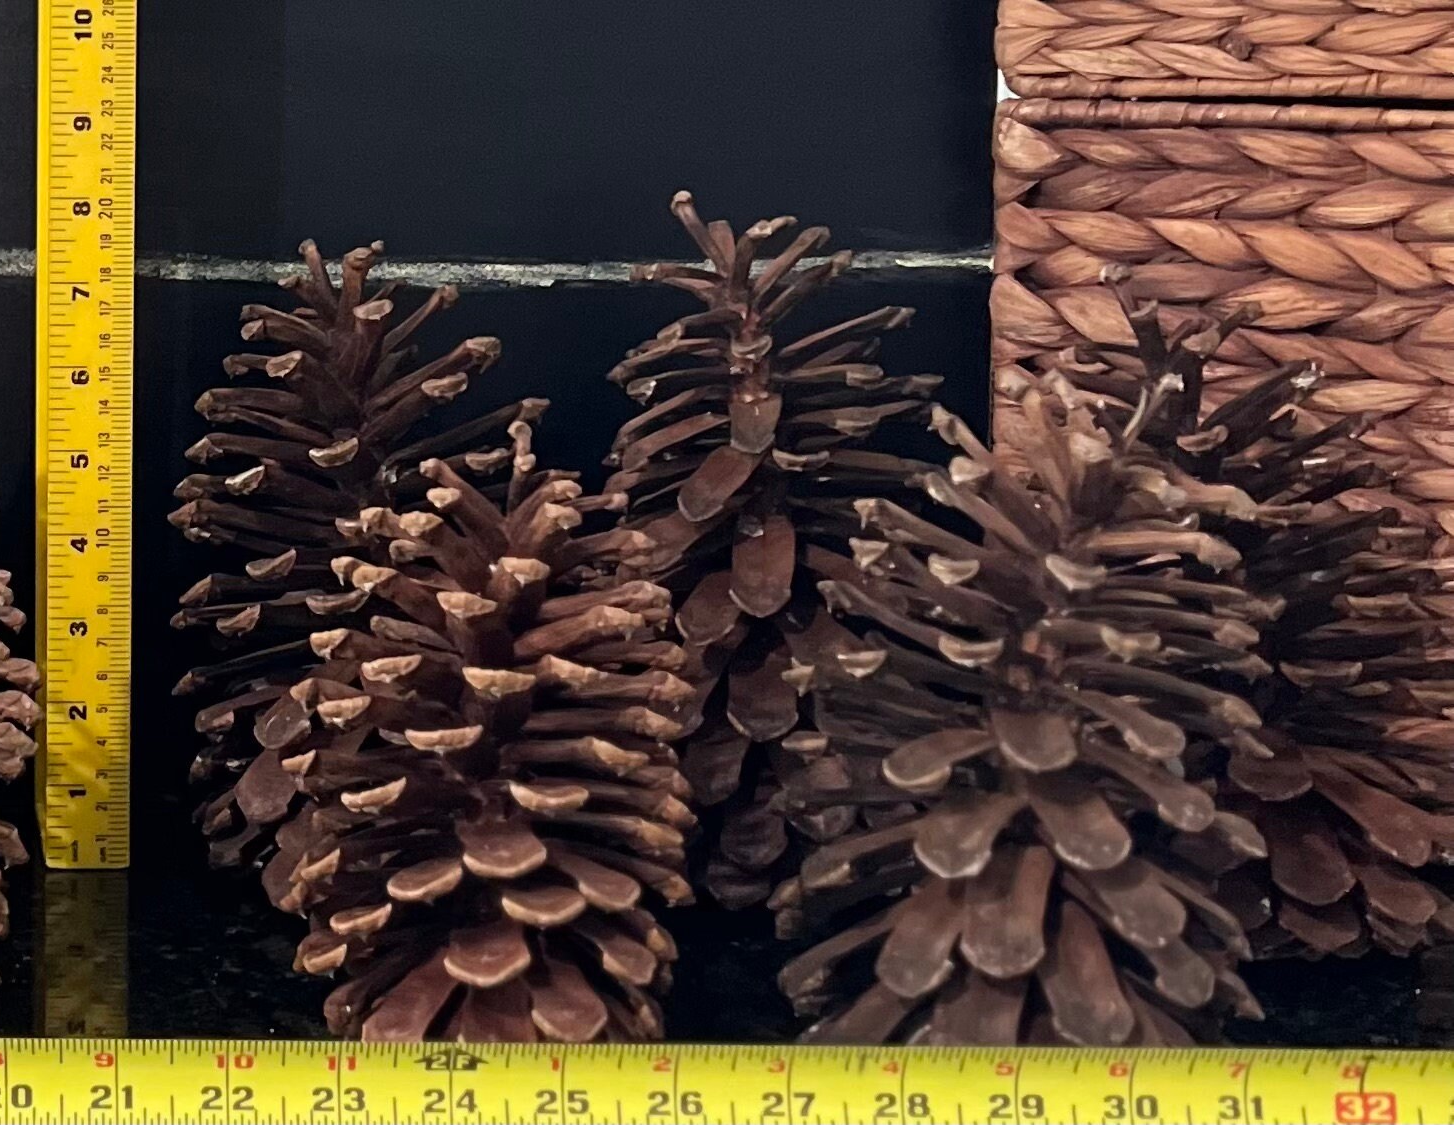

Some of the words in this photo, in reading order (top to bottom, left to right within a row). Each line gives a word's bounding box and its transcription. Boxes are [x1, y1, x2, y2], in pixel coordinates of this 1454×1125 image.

[74, 9, 92, 41] 10
[102, 32, 114, 50] 25
[101, 66, 113, 83] 24
[101, 100, 113, 117] 23
[74, 116, 92, 131] 9
[101, 134, 113, 150] 22
[101, 167, 112, 184] 21
[73, 202, 91, 216] 8
[98, 198, 113, 219] 20
[100, 234, 112, 249] 19
[100, 267, 111, 282] 18
[72, 287, 90, 301] 7
[100, 301, 111, 315] 17
[99, 333, 111, 349] 16
[71, 370, 89, 385] 6
[99, 366, 110, 381] 15
[99, 400, 110, 415] 14
[98, 433, 110, 448] 13
[71, 454, 88, 468] 5
[98, 466, 110, 481] 12
[98, 499, 108, 513] 11
[71, 538, 88, 552] 4
[96, 529, 110, 548] 10
[70, 622, 87, 636] 3
[69, 705, 86, 720] 2
[68, 790, 86, 798] 1
[95, 1053, 114, 1067] 9
[216, 1054, 254, 1069] 10
[327, 1056, 356, 1070] 11
[551, 1057, 559, 1071] 1
[653, 1057, 672, 1071] 2
[768, 1059, 785, 1073] 3
[883, 1061, 899, 1074] 4
[996, 1063, 1014, 1076] 5
[1108, 1063, 1128, 1077] 6
[1229, 1063, 1247, 1078] 7
[1342, 1065, 1362, 1079] 8
[90, 1084, 133, 1110] 21
[201, 1086, 255, 1111] 22
[312, 1087, 365, 1112] 23
[423, 1089, 478, 1114] 24
[535, 1089, 589, 1115] 25
[648, 1090, 703, 1116] 26
[762, 1092, 816, 1118] 27
[874, 1092, 930, 1118] 28
[988, 1094, 1045, 1119] 29
[1103, 1095, 1158, 1120] 30
[1218, 1095, 1263, 1120] 31
[1340, 1096, 1393, 1120] 32
